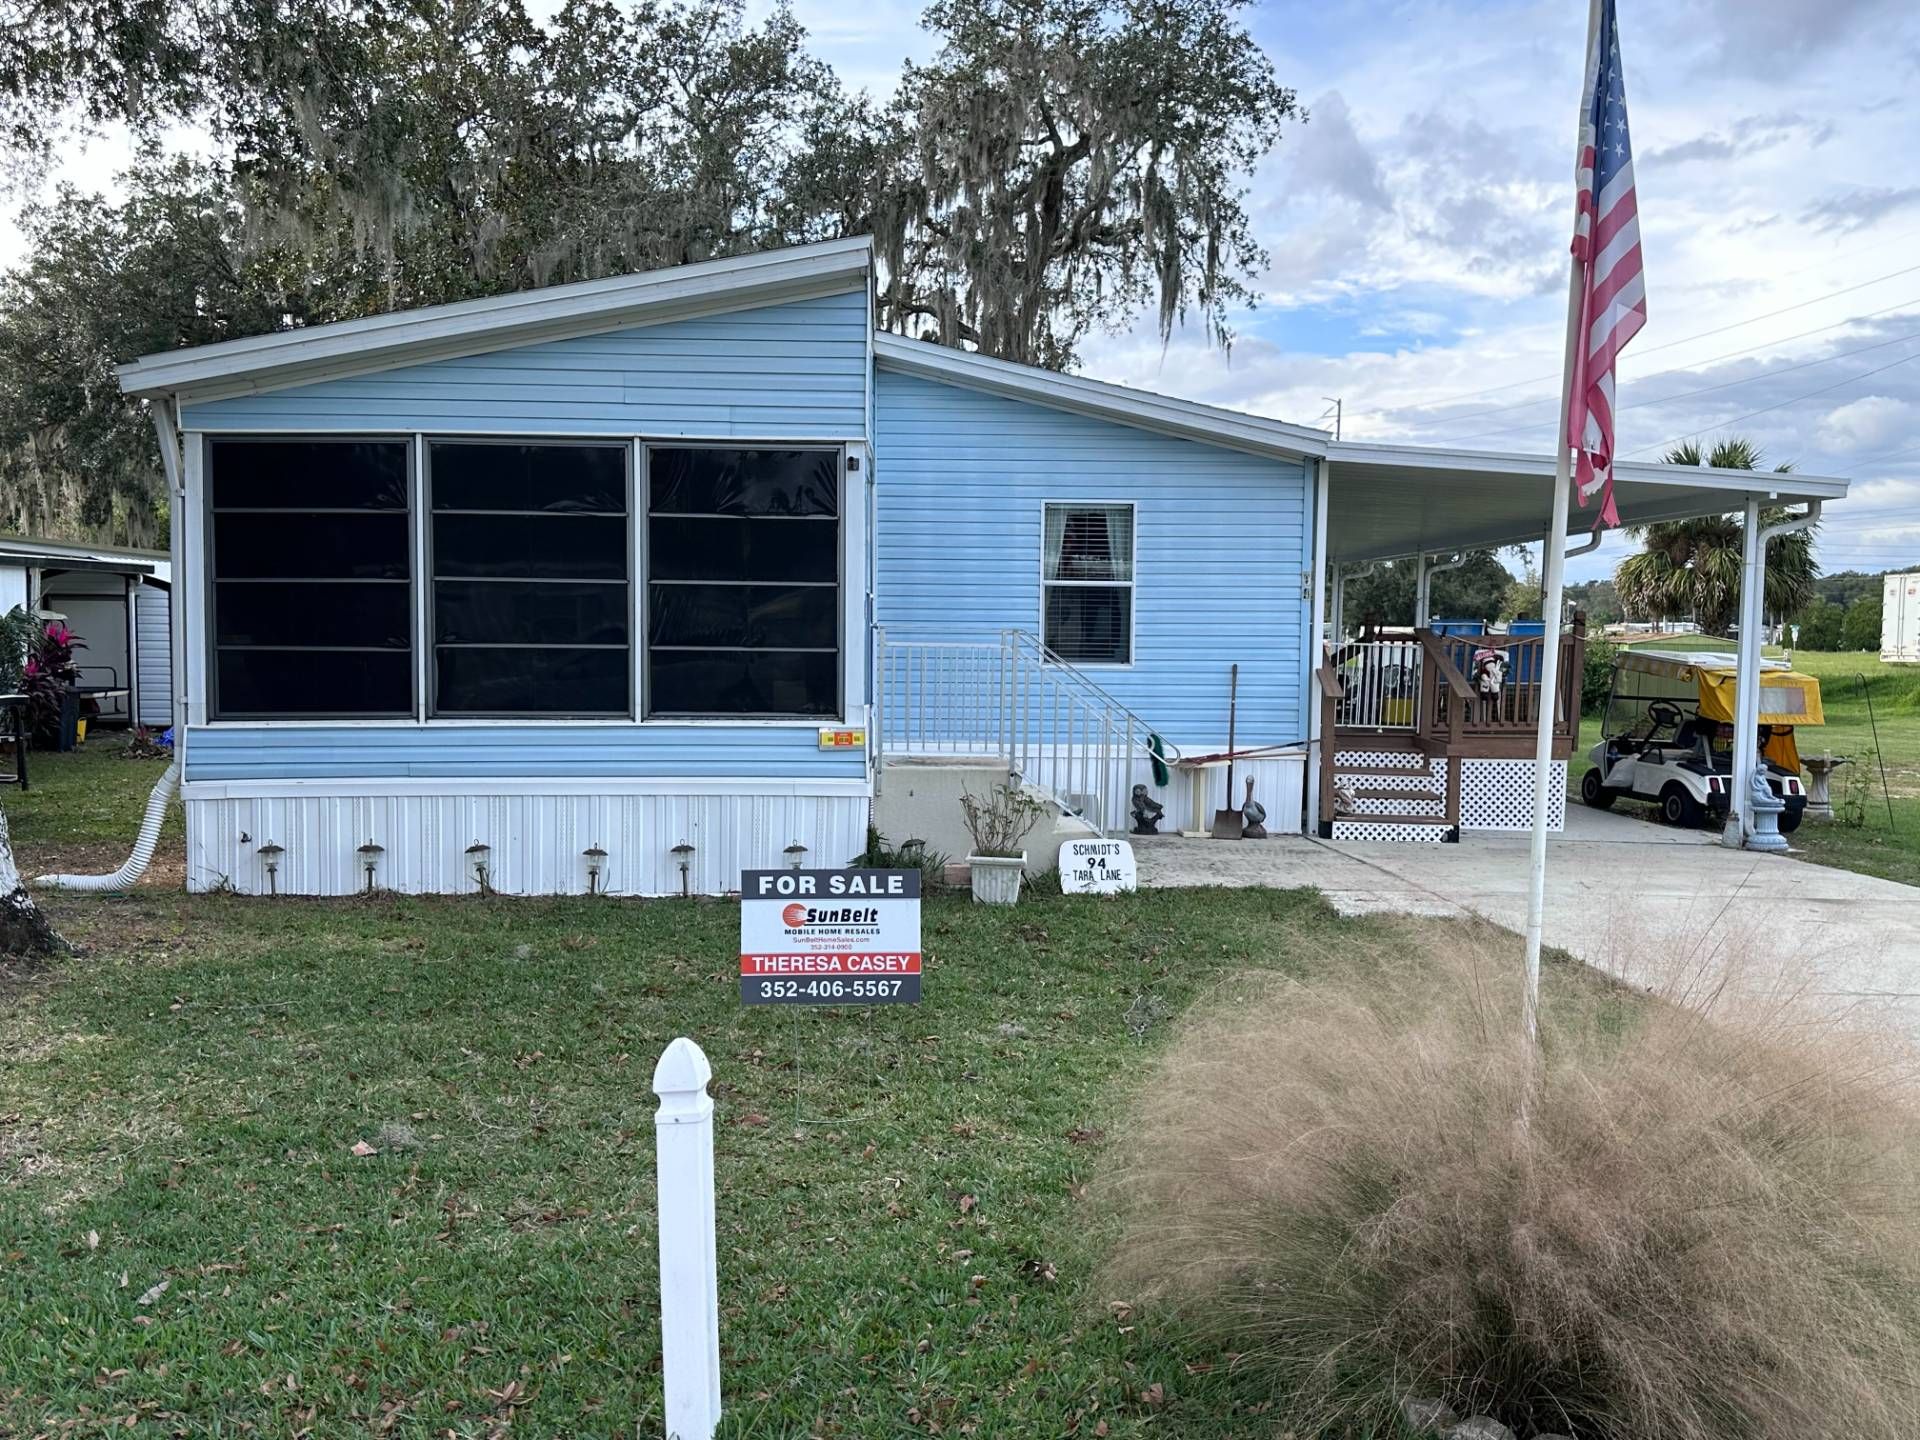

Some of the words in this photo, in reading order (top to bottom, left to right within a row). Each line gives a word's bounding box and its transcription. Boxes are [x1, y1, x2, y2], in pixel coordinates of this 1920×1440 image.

[1073, 844, 1120, 855] SCHMIDT'S
[1087, 857, 1106, 869] 94
[1073, 870, 1094, 881] TARA
[1100, 869, 1122, 880] LANE
[759, 875, 816, 894] FOR
[829, 875, 904, 894] SALE
[806, 908, 878, 922] SunBelt
[752, 957, 842, 972] THERESA
[847, 955, 910, 971] CASEY
[760, 980, 902, 998] 352-406-5567
